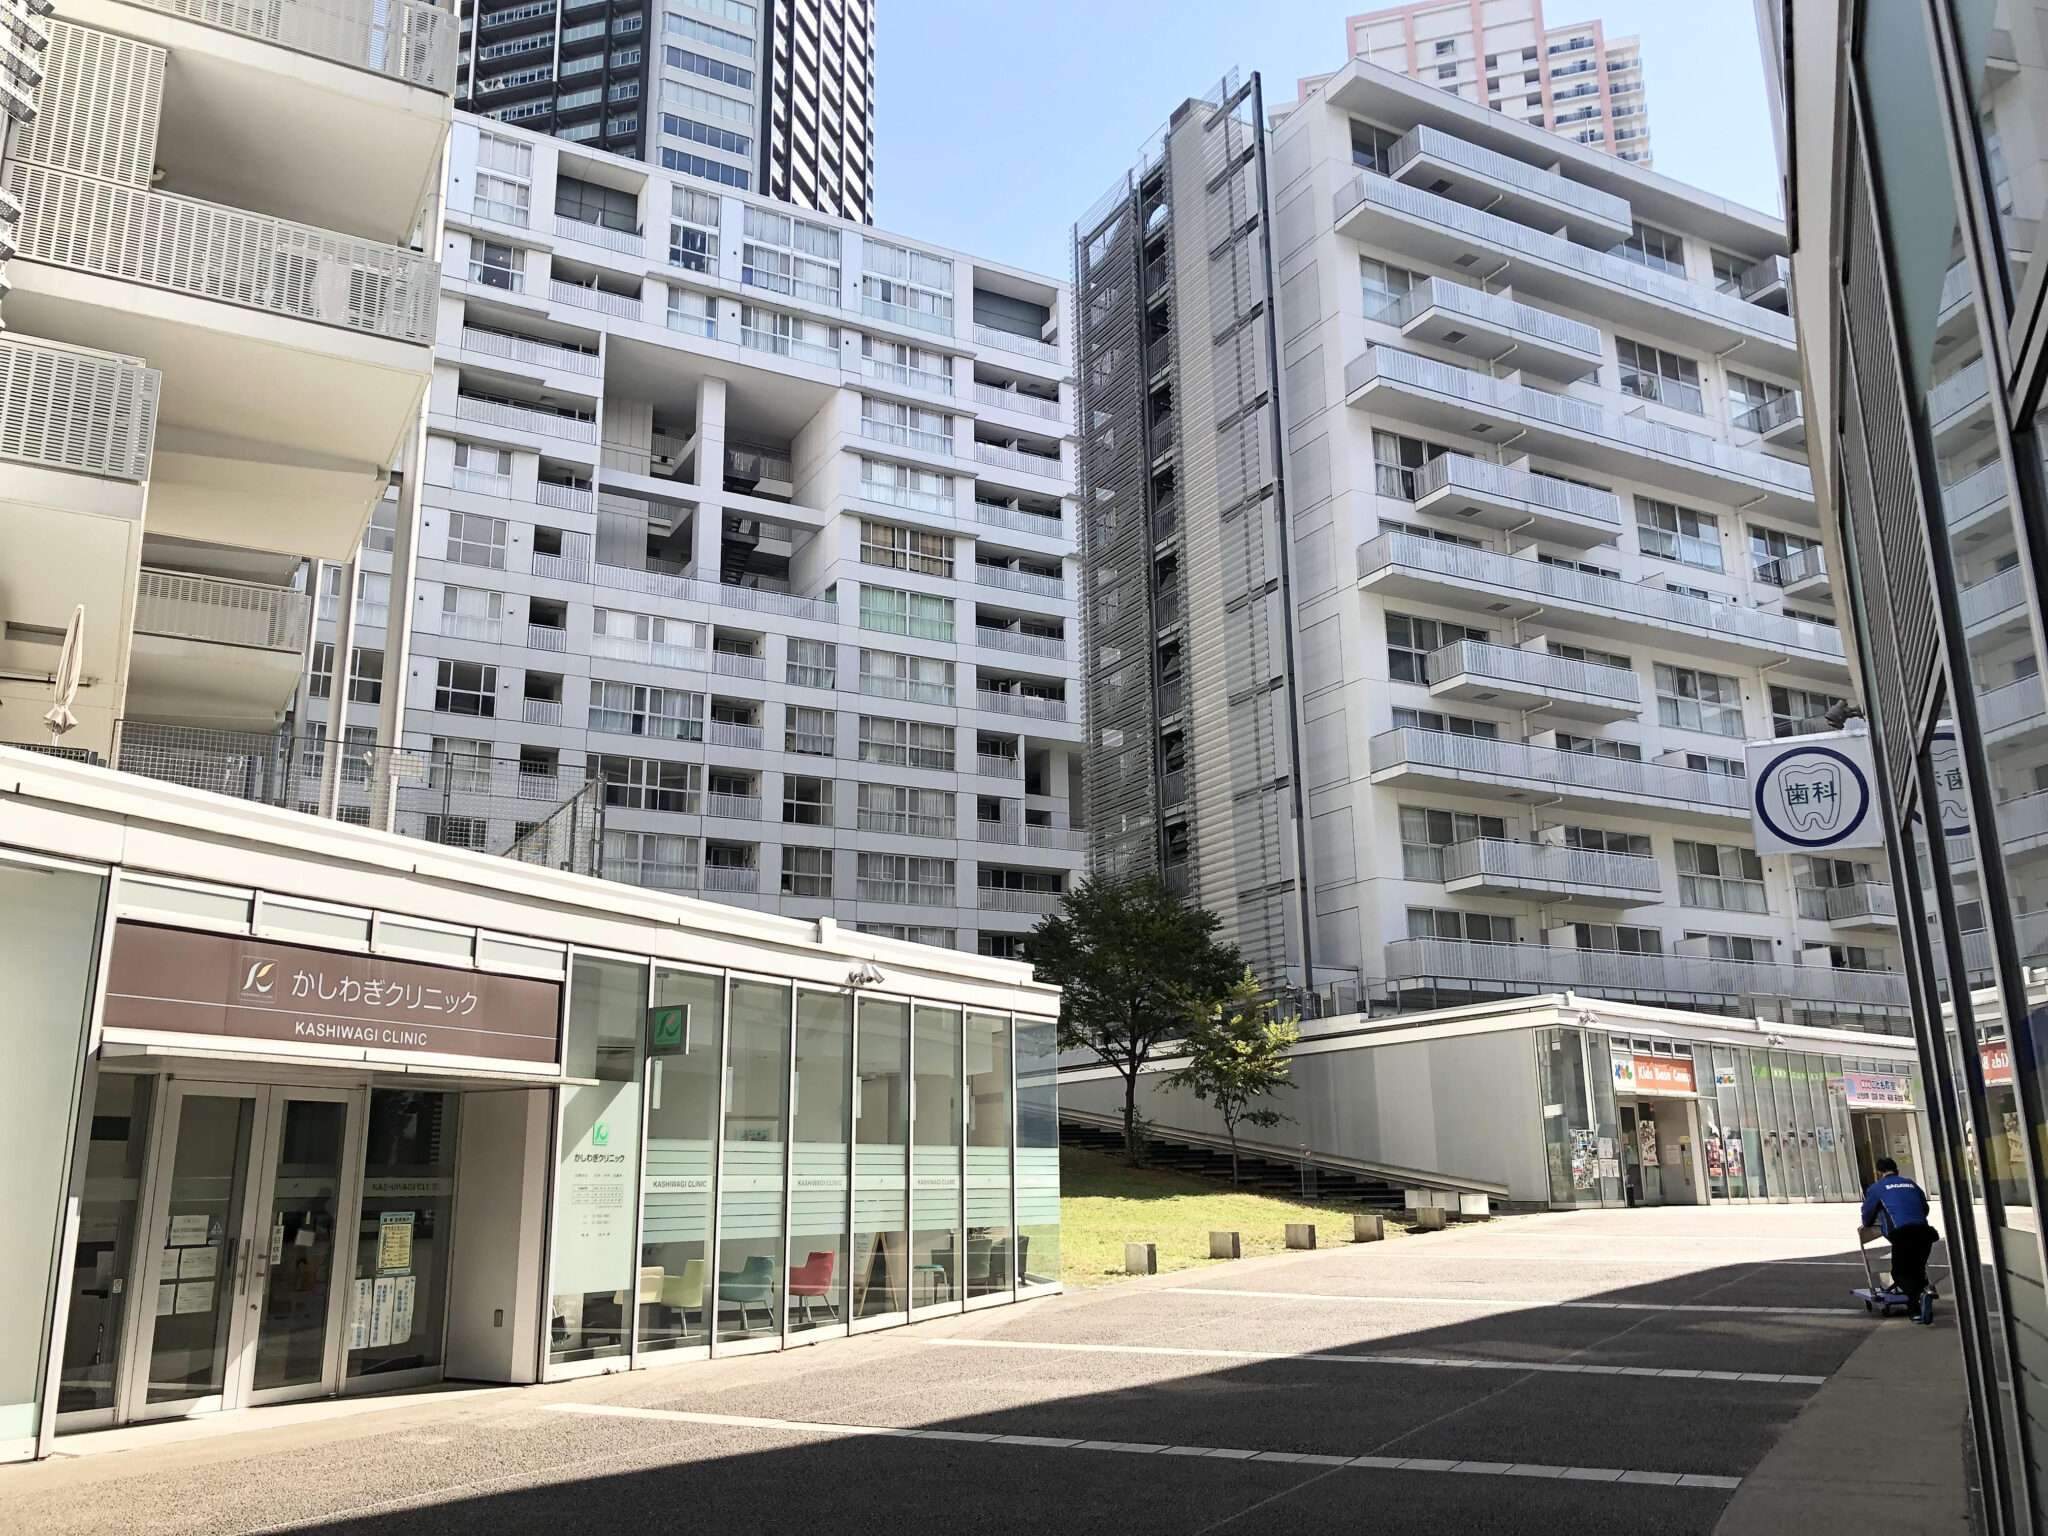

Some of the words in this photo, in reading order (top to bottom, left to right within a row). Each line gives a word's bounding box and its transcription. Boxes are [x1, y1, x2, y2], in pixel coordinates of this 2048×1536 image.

[1785, 781, 1837, 806] 歯科
[291, 970, 478, 1015] かしわぎクリニック
[295, 1021, 378, 1042] KASHIWAGI
[382, 1030, 428, 1046] CLINIC
[574, 1153, 625, 1163] かしわぎクリニック
[653, 1180, 687, 1188] KASHIWAGI
[688, 1180, 707, 1188] CLINIC
